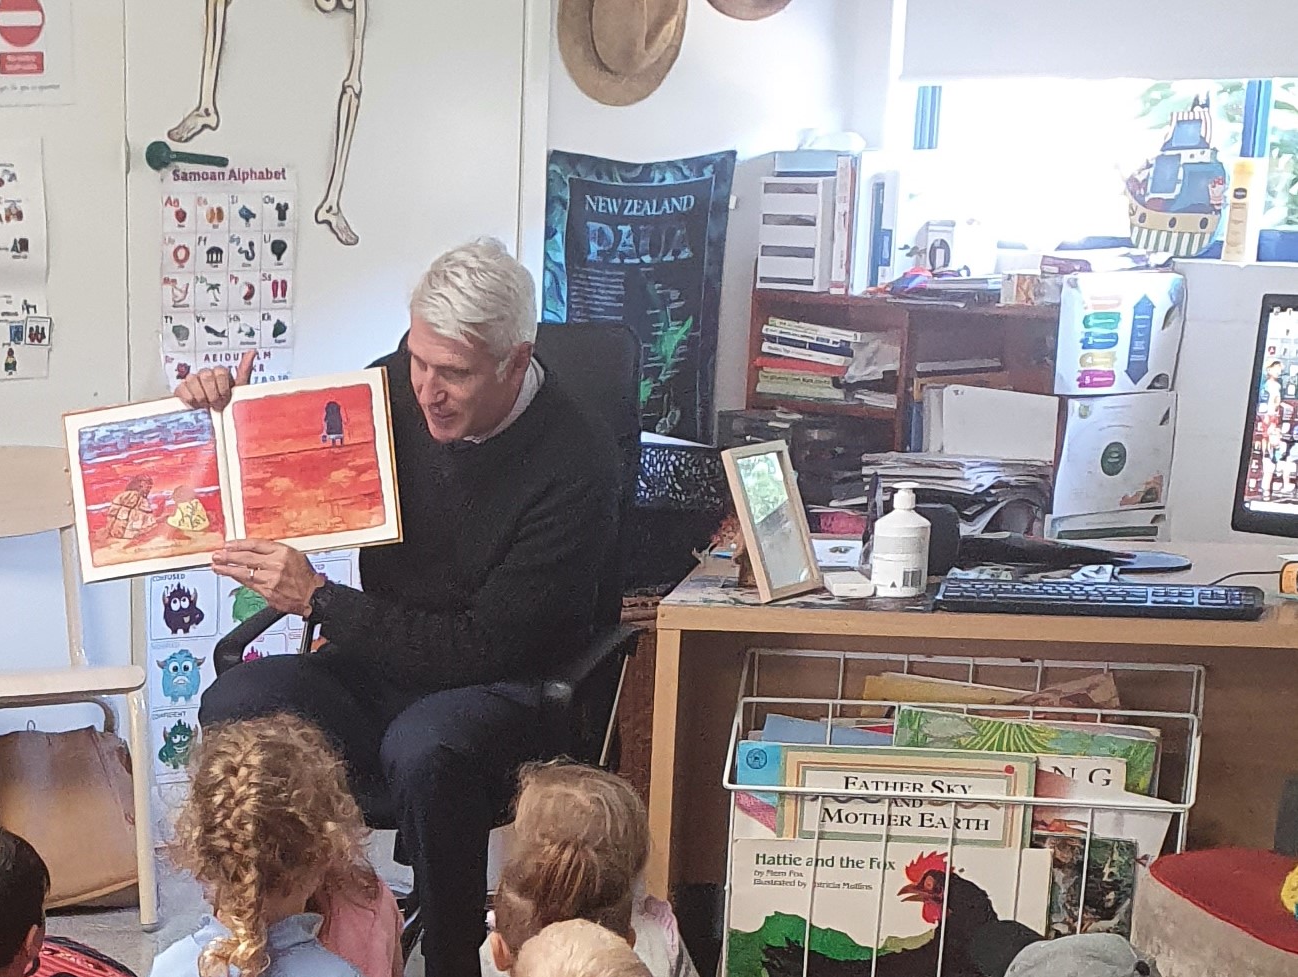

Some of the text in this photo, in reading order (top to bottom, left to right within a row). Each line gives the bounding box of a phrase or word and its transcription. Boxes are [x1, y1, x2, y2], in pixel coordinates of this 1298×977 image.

[172, 167, 287, 183] Samoan Alphabet
[585, 194, 695, 216] NEW ZEALAND
[586, 221, 694, 264] PAUA
[844, 775, 973, 795] FATHER SKY
[890, 797, 923, 809] AND
[821, 807, 990, 831] MOTHER EARTH
[755, 852, 896, 871] Hattie and the Fox
[797, 879, 807, 889] by
[812, 881, 841, 889] atricia
